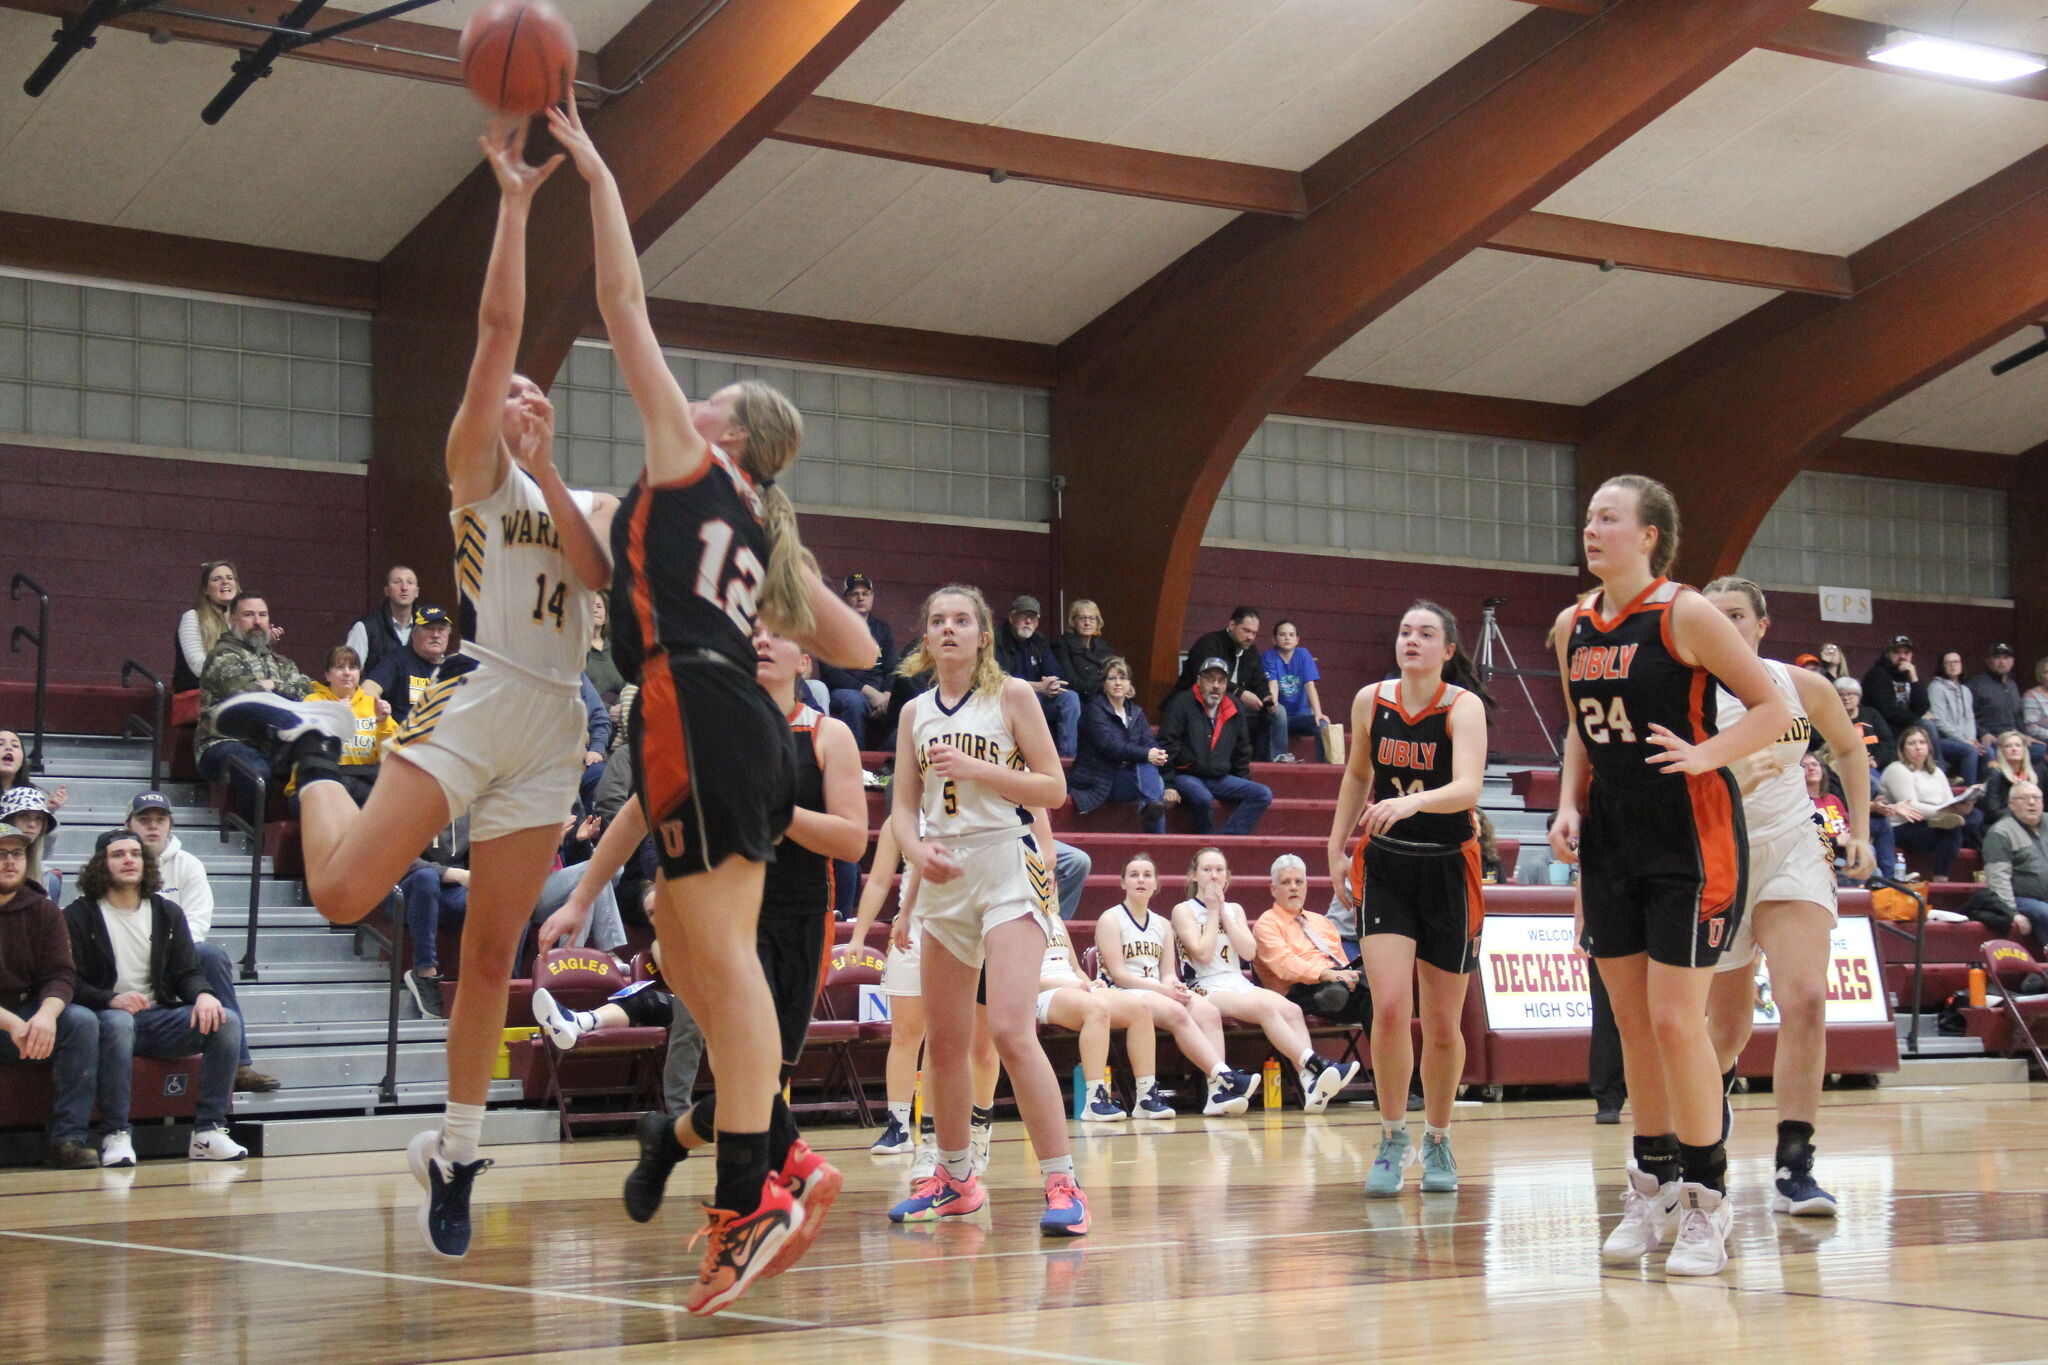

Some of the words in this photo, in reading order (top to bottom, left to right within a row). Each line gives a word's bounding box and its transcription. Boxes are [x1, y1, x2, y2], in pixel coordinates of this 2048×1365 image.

[693, 517, 767, 638] 12
[531, 573, 569, 632] 14
[1569, 642, 1639, 682] UBLY
[1578, 696, 1637, 743] 24
[1377, 736, 1438, 771] UBLY
[942, 780, 959, 817] 5
[660, 819, 685, 858] U
[1708, 917, 1725, 948] U
[1830, 938, 1848, 950] HE
[548, 957, 609, 976] EAGLES
[1220, 945, 1229, 964] 4
[1524, 1002, 1562, 1018] HIGH
